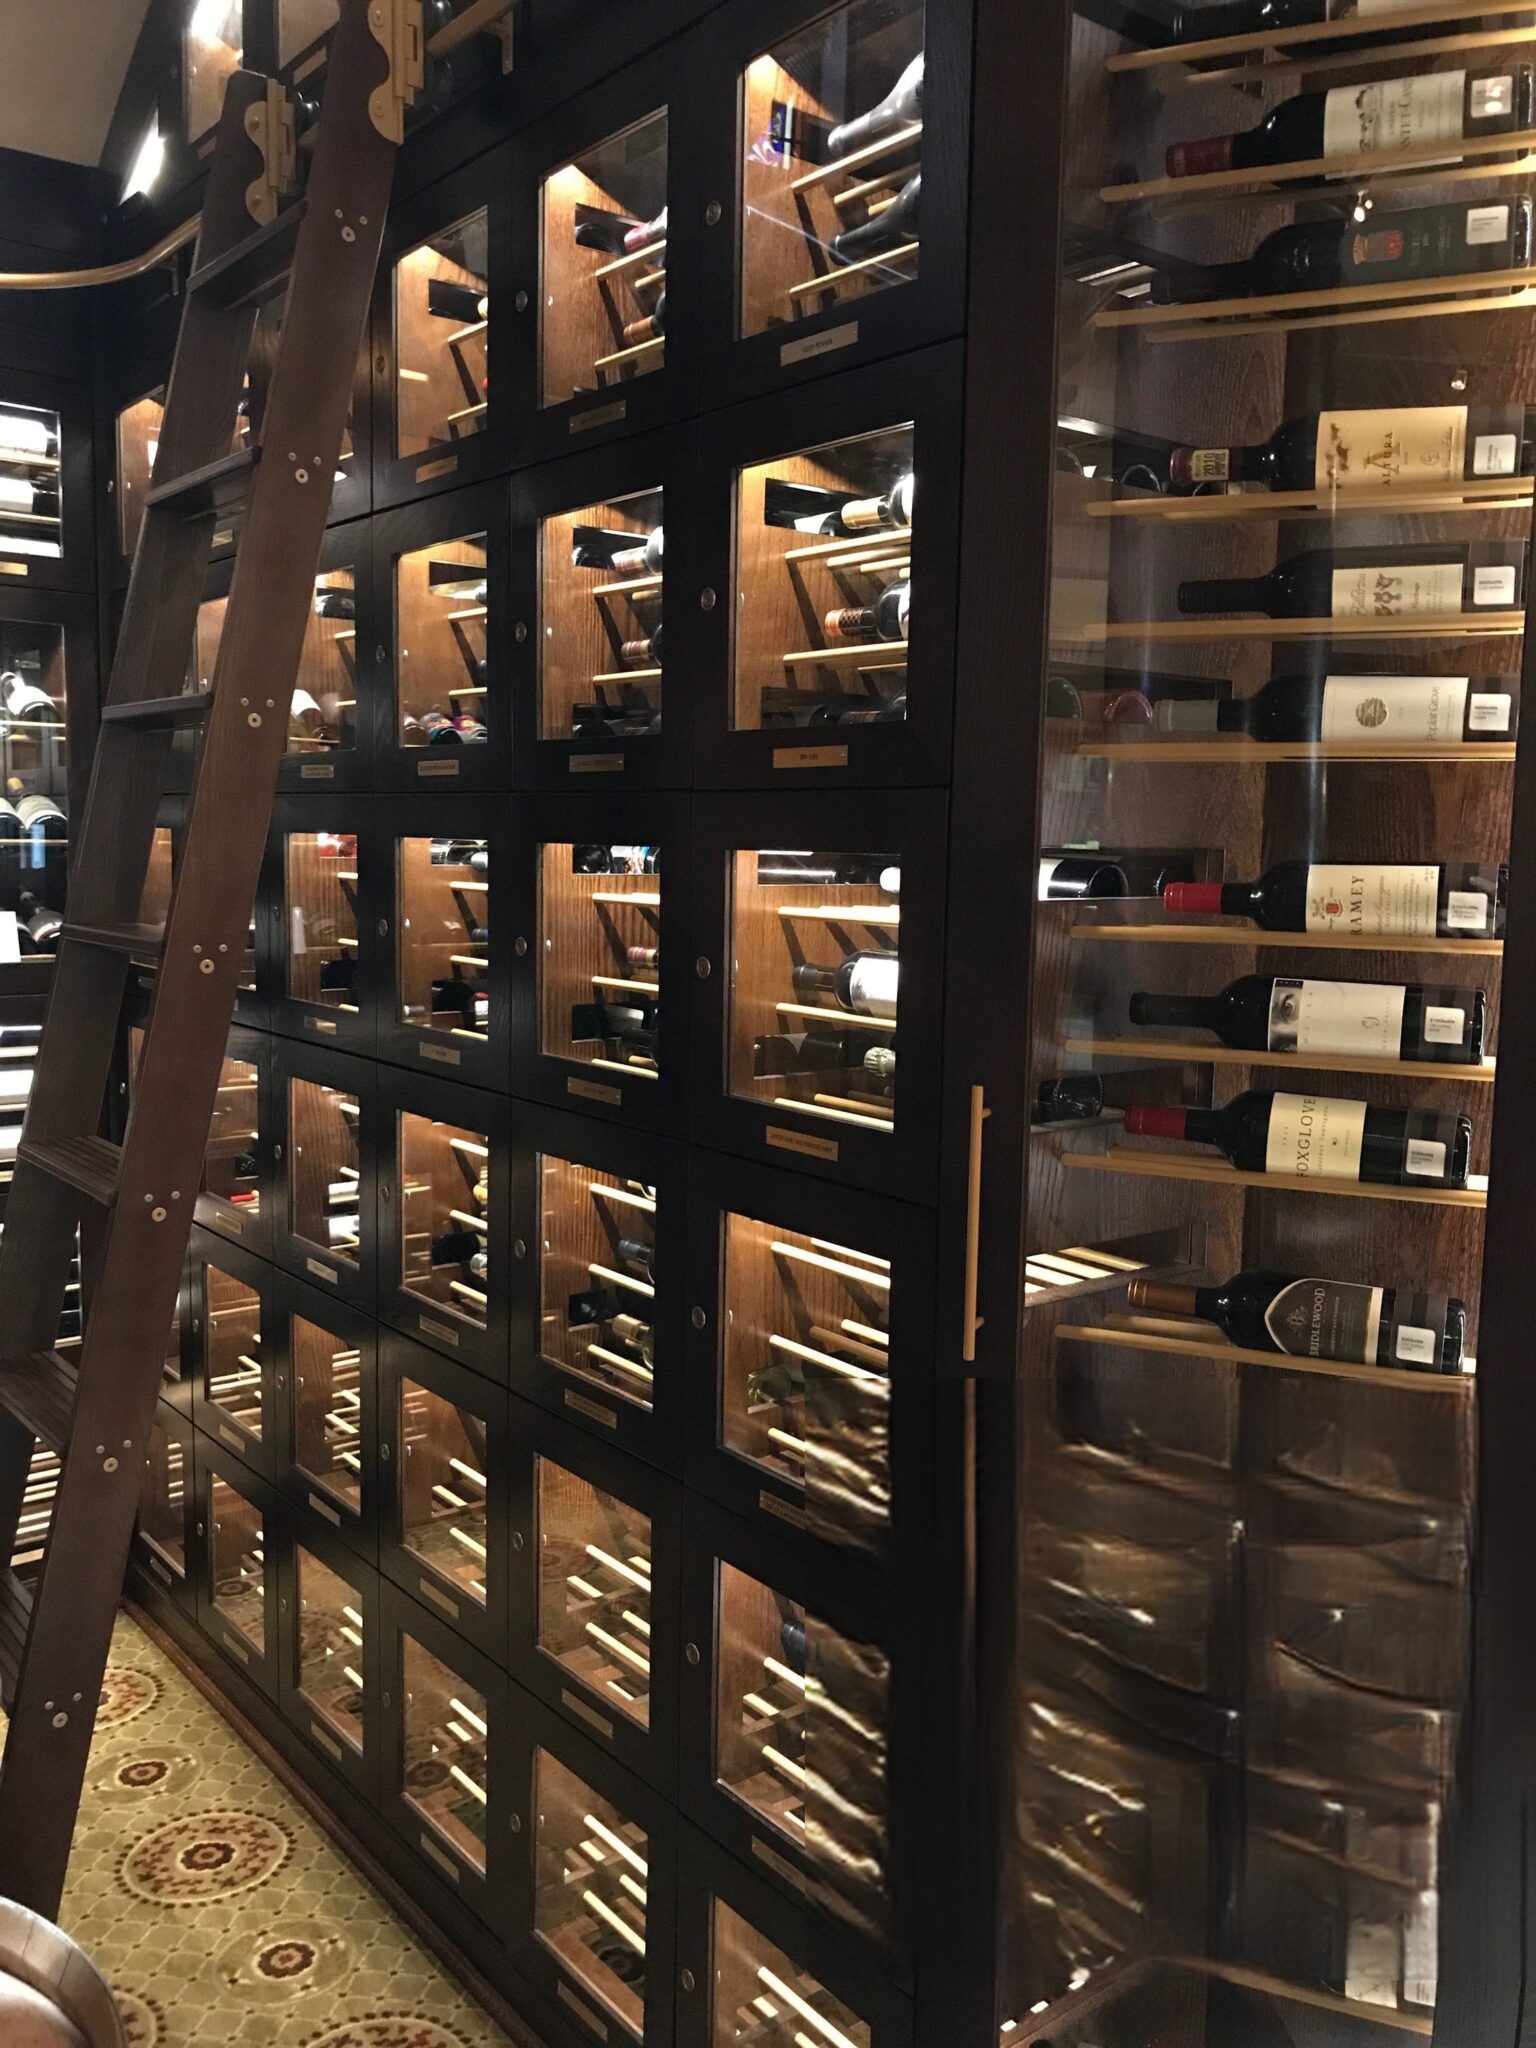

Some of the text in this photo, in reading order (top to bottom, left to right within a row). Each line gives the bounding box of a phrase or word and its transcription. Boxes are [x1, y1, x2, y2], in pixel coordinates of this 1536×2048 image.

[1203, 453, 1215, 477] 2010
[1382, 431, 1393, 487] ALTURA
[1426, 686, 1440, 740] Poplar Grove
[1350, 875, 1364, 936] RAMEY
[1296, 1099, 1316, 1177] FOXGLOVE
[1309, 1287, 1325, 1356] BRIDLEWOOD
